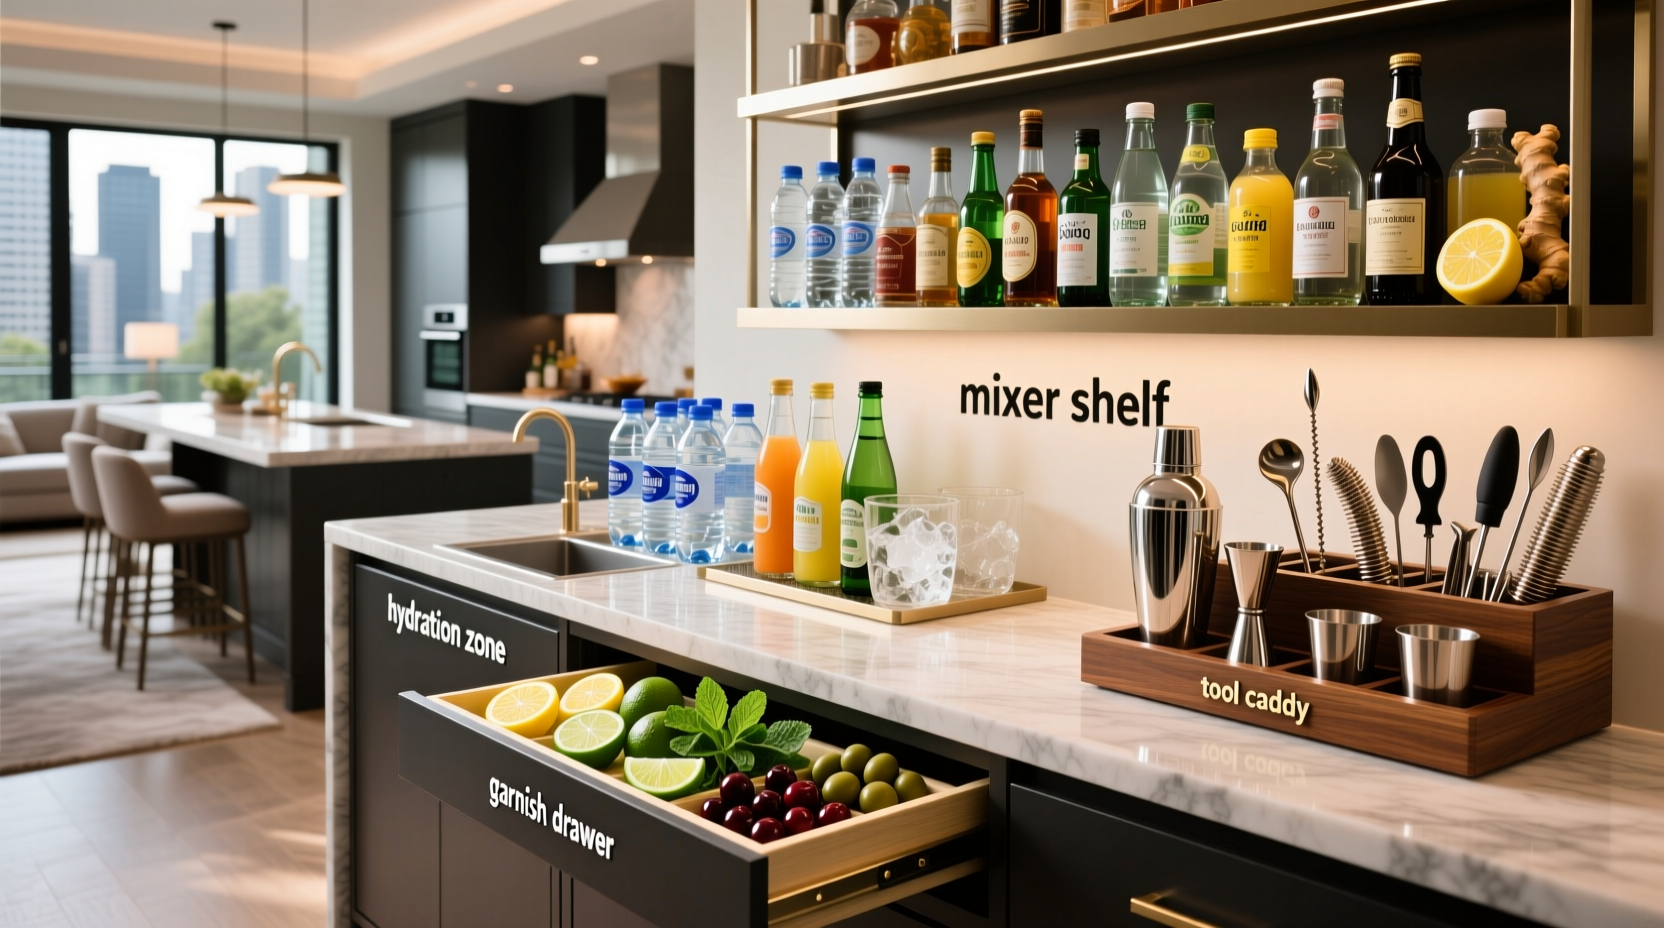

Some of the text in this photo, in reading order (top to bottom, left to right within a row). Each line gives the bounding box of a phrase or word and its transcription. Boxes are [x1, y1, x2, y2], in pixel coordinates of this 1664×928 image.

[960, 372, 1171, 426] mixer shelf
[387, 593, 507, 664] hydration zone
[1200, 676, 1310, 726] tool caddy
[489, 776, 617, 859] garnish drawer
